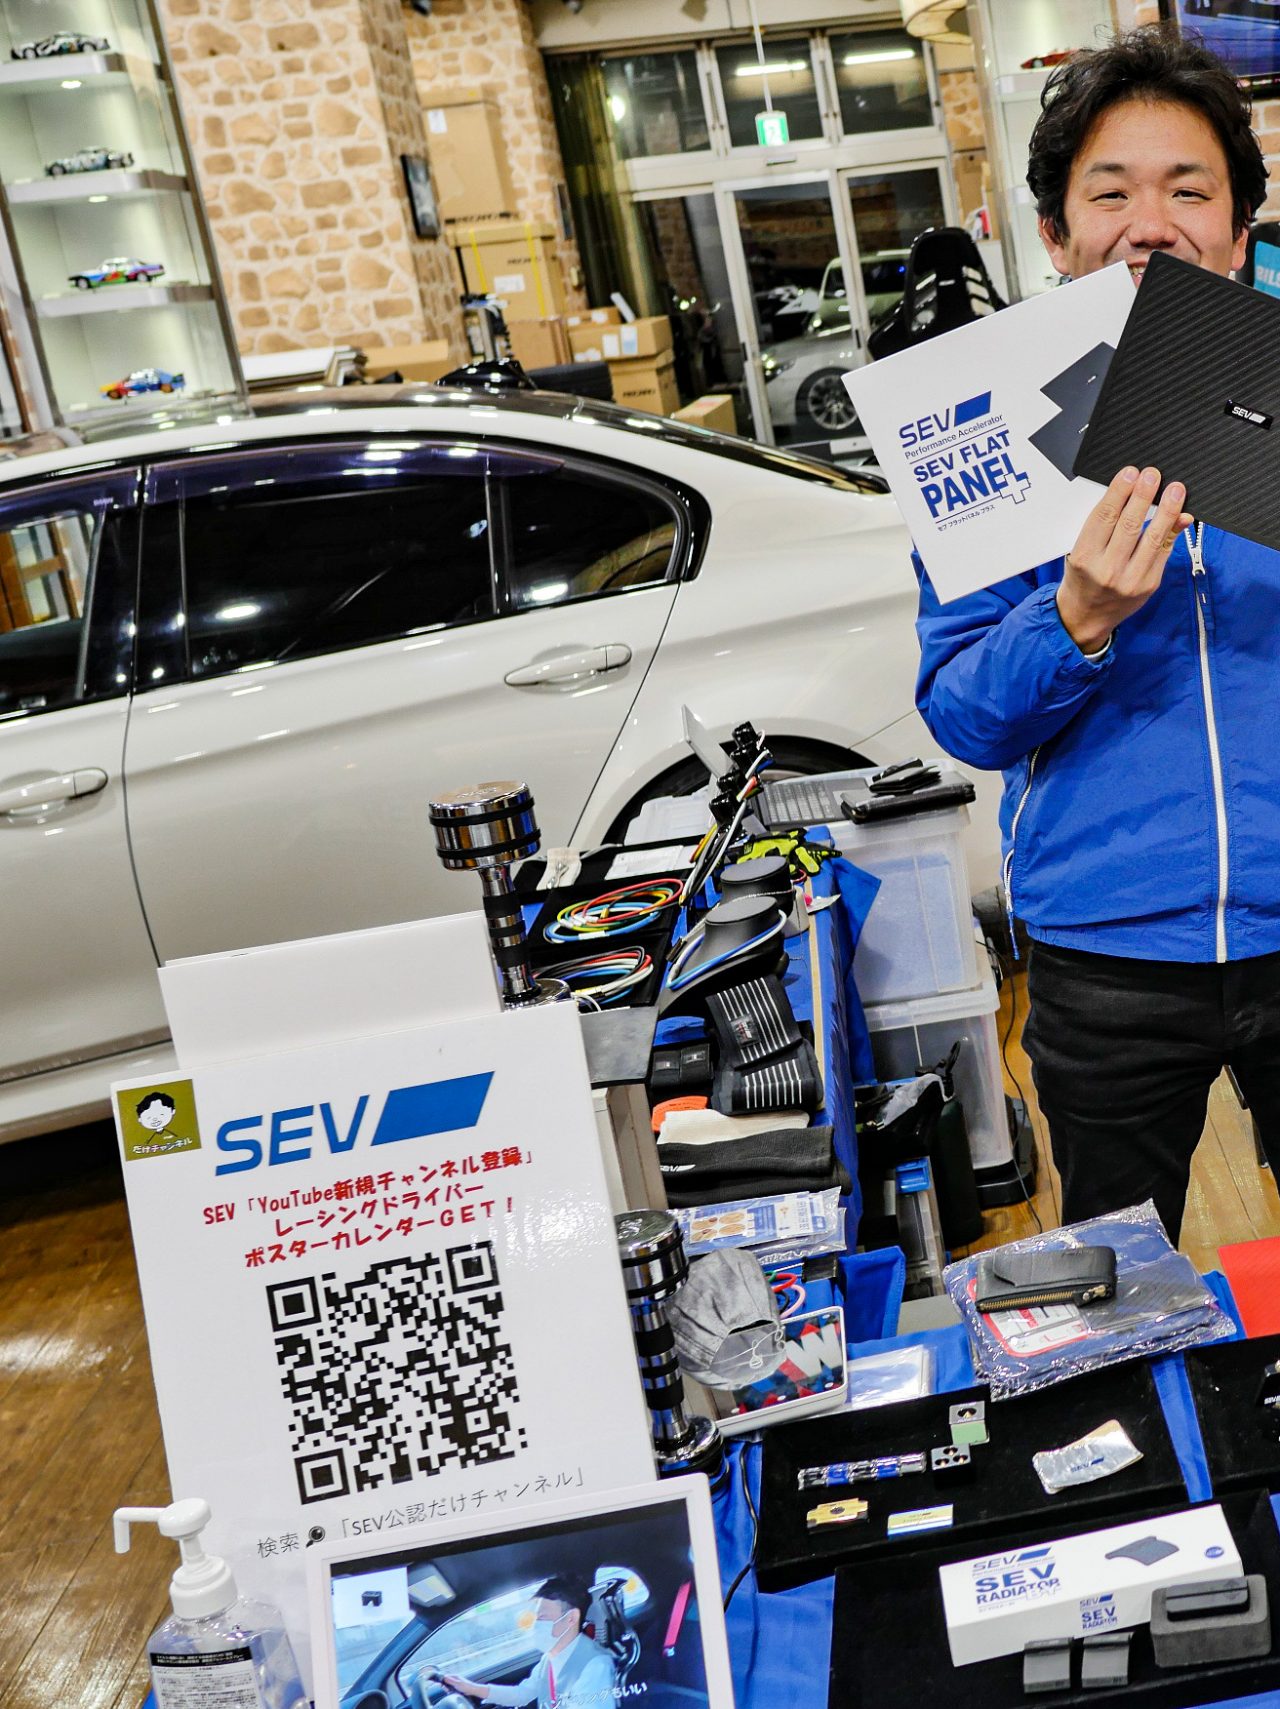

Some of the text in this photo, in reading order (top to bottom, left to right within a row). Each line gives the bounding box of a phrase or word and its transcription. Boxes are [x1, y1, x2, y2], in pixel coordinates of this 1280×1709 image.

[899, 408, 950, 448] SEV
[904, 414, 1004, 460] Performance Accelerator
[913, 429, 1011, 482] SEV FLAT
[920, 453, 1029, 519] PANEL
[215, 1094, 370, 1177] SEV
[203, 1146, 533, 1225] SEV 「YouTube新規チャンネル登録」
[275, 1184, 484, 1237] レーシングドライバー
[257, 1467, 584, 1559] 検索 「SEV公認だけチャンネル」
[973, 1555, 1017, 1569] SEV
[975, 1563, 1055, 1593] SEV
[976, 1578, 1060, 1605] RADIATOR
[1082, 1606, 1116, 1623] SEV
